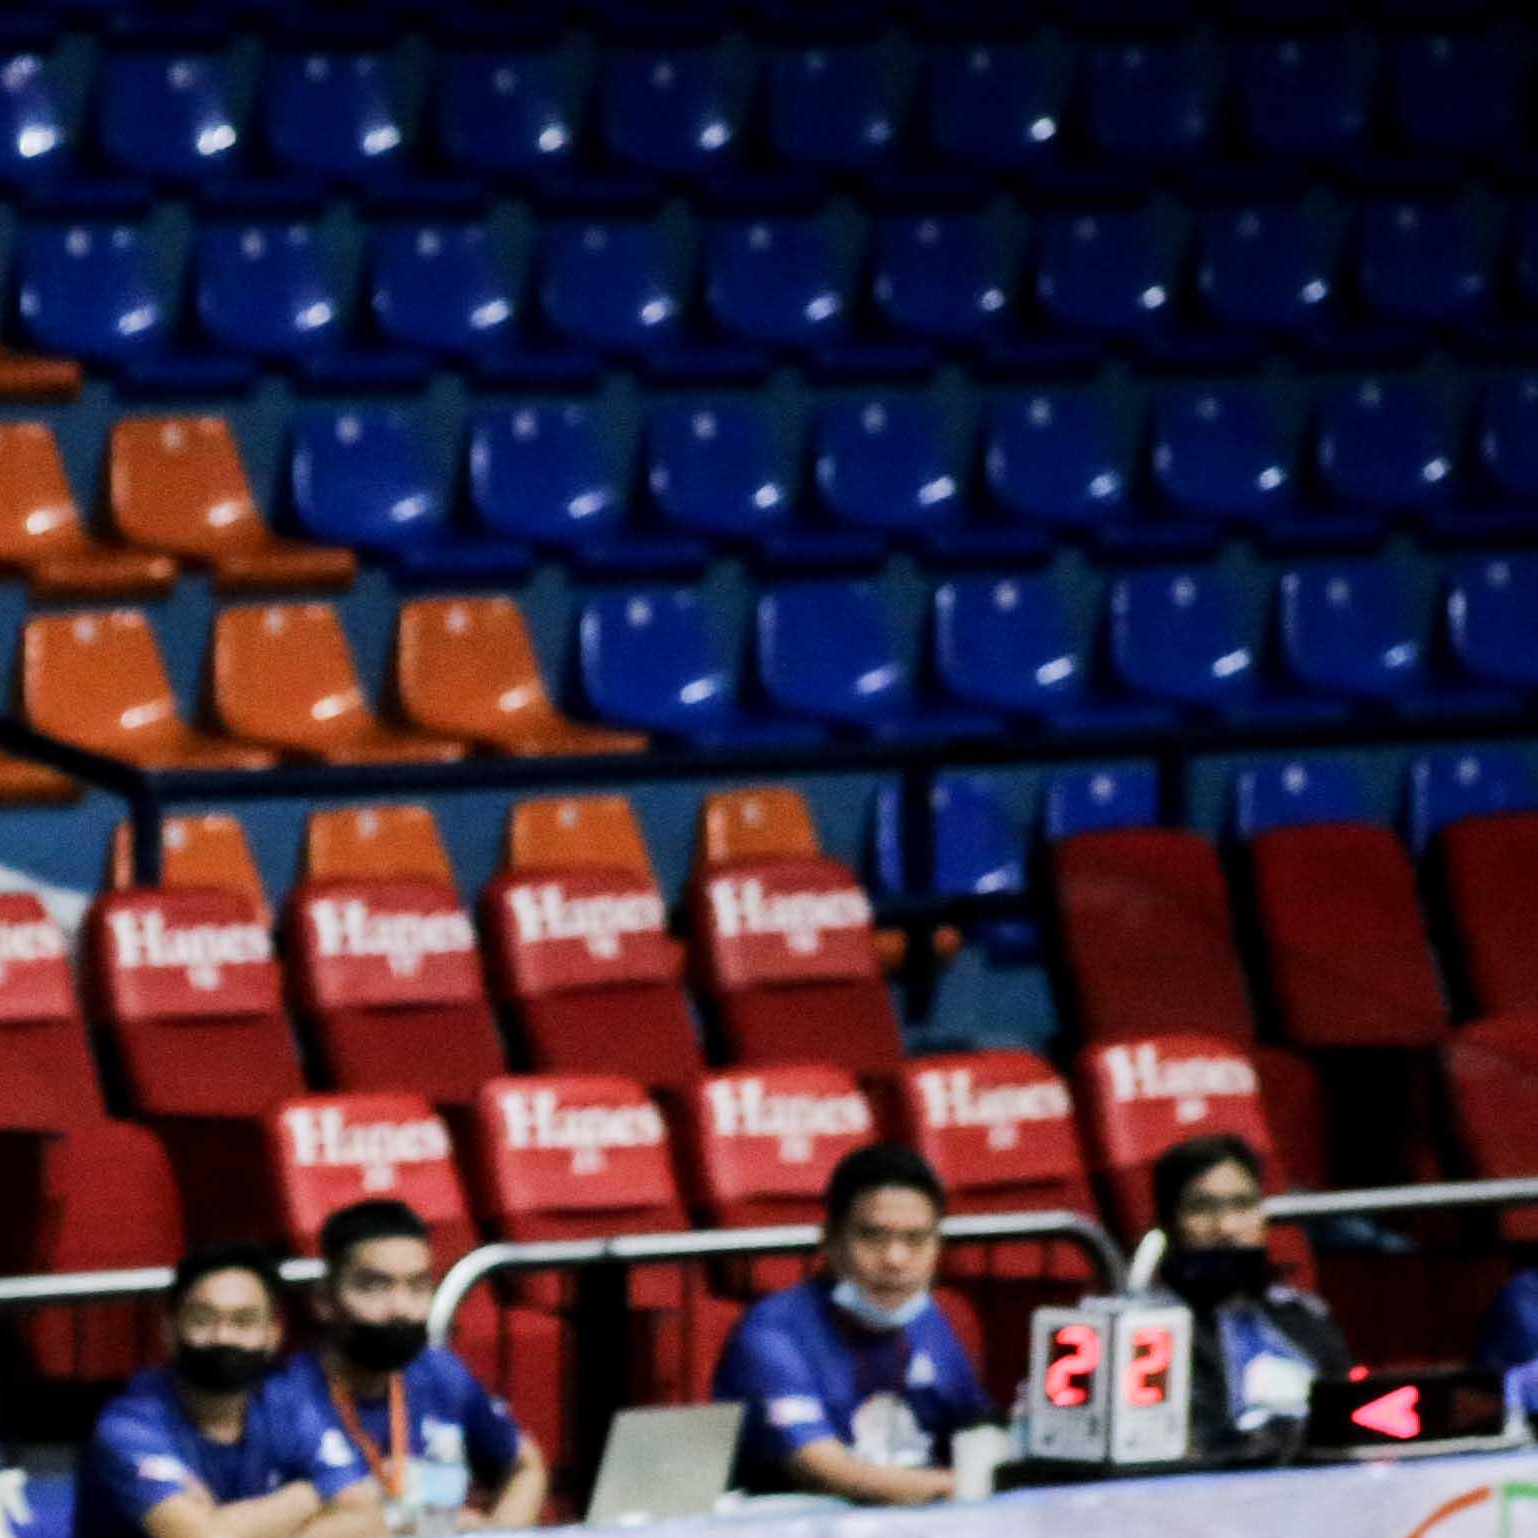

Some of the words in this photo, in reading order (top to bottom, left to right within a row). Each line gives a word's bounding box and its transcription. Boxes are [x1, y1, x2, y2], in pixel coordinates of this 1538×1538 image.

[310, 897, 476, 958] Hanes
[507, 883, 667, 944] Hanes
[708, 874, 872, 936] Hanes
[108, 906, 271, 969] Hanes
[915, 1068, 1072, 1131] Hanes
[1105, 1042, 1259, 1104] Hanes
[281, 1106, 452, 1166] Hanes
[500, 1088, 667, 1151] Hanes
[704, 1077, 874, 1143] Hanes
